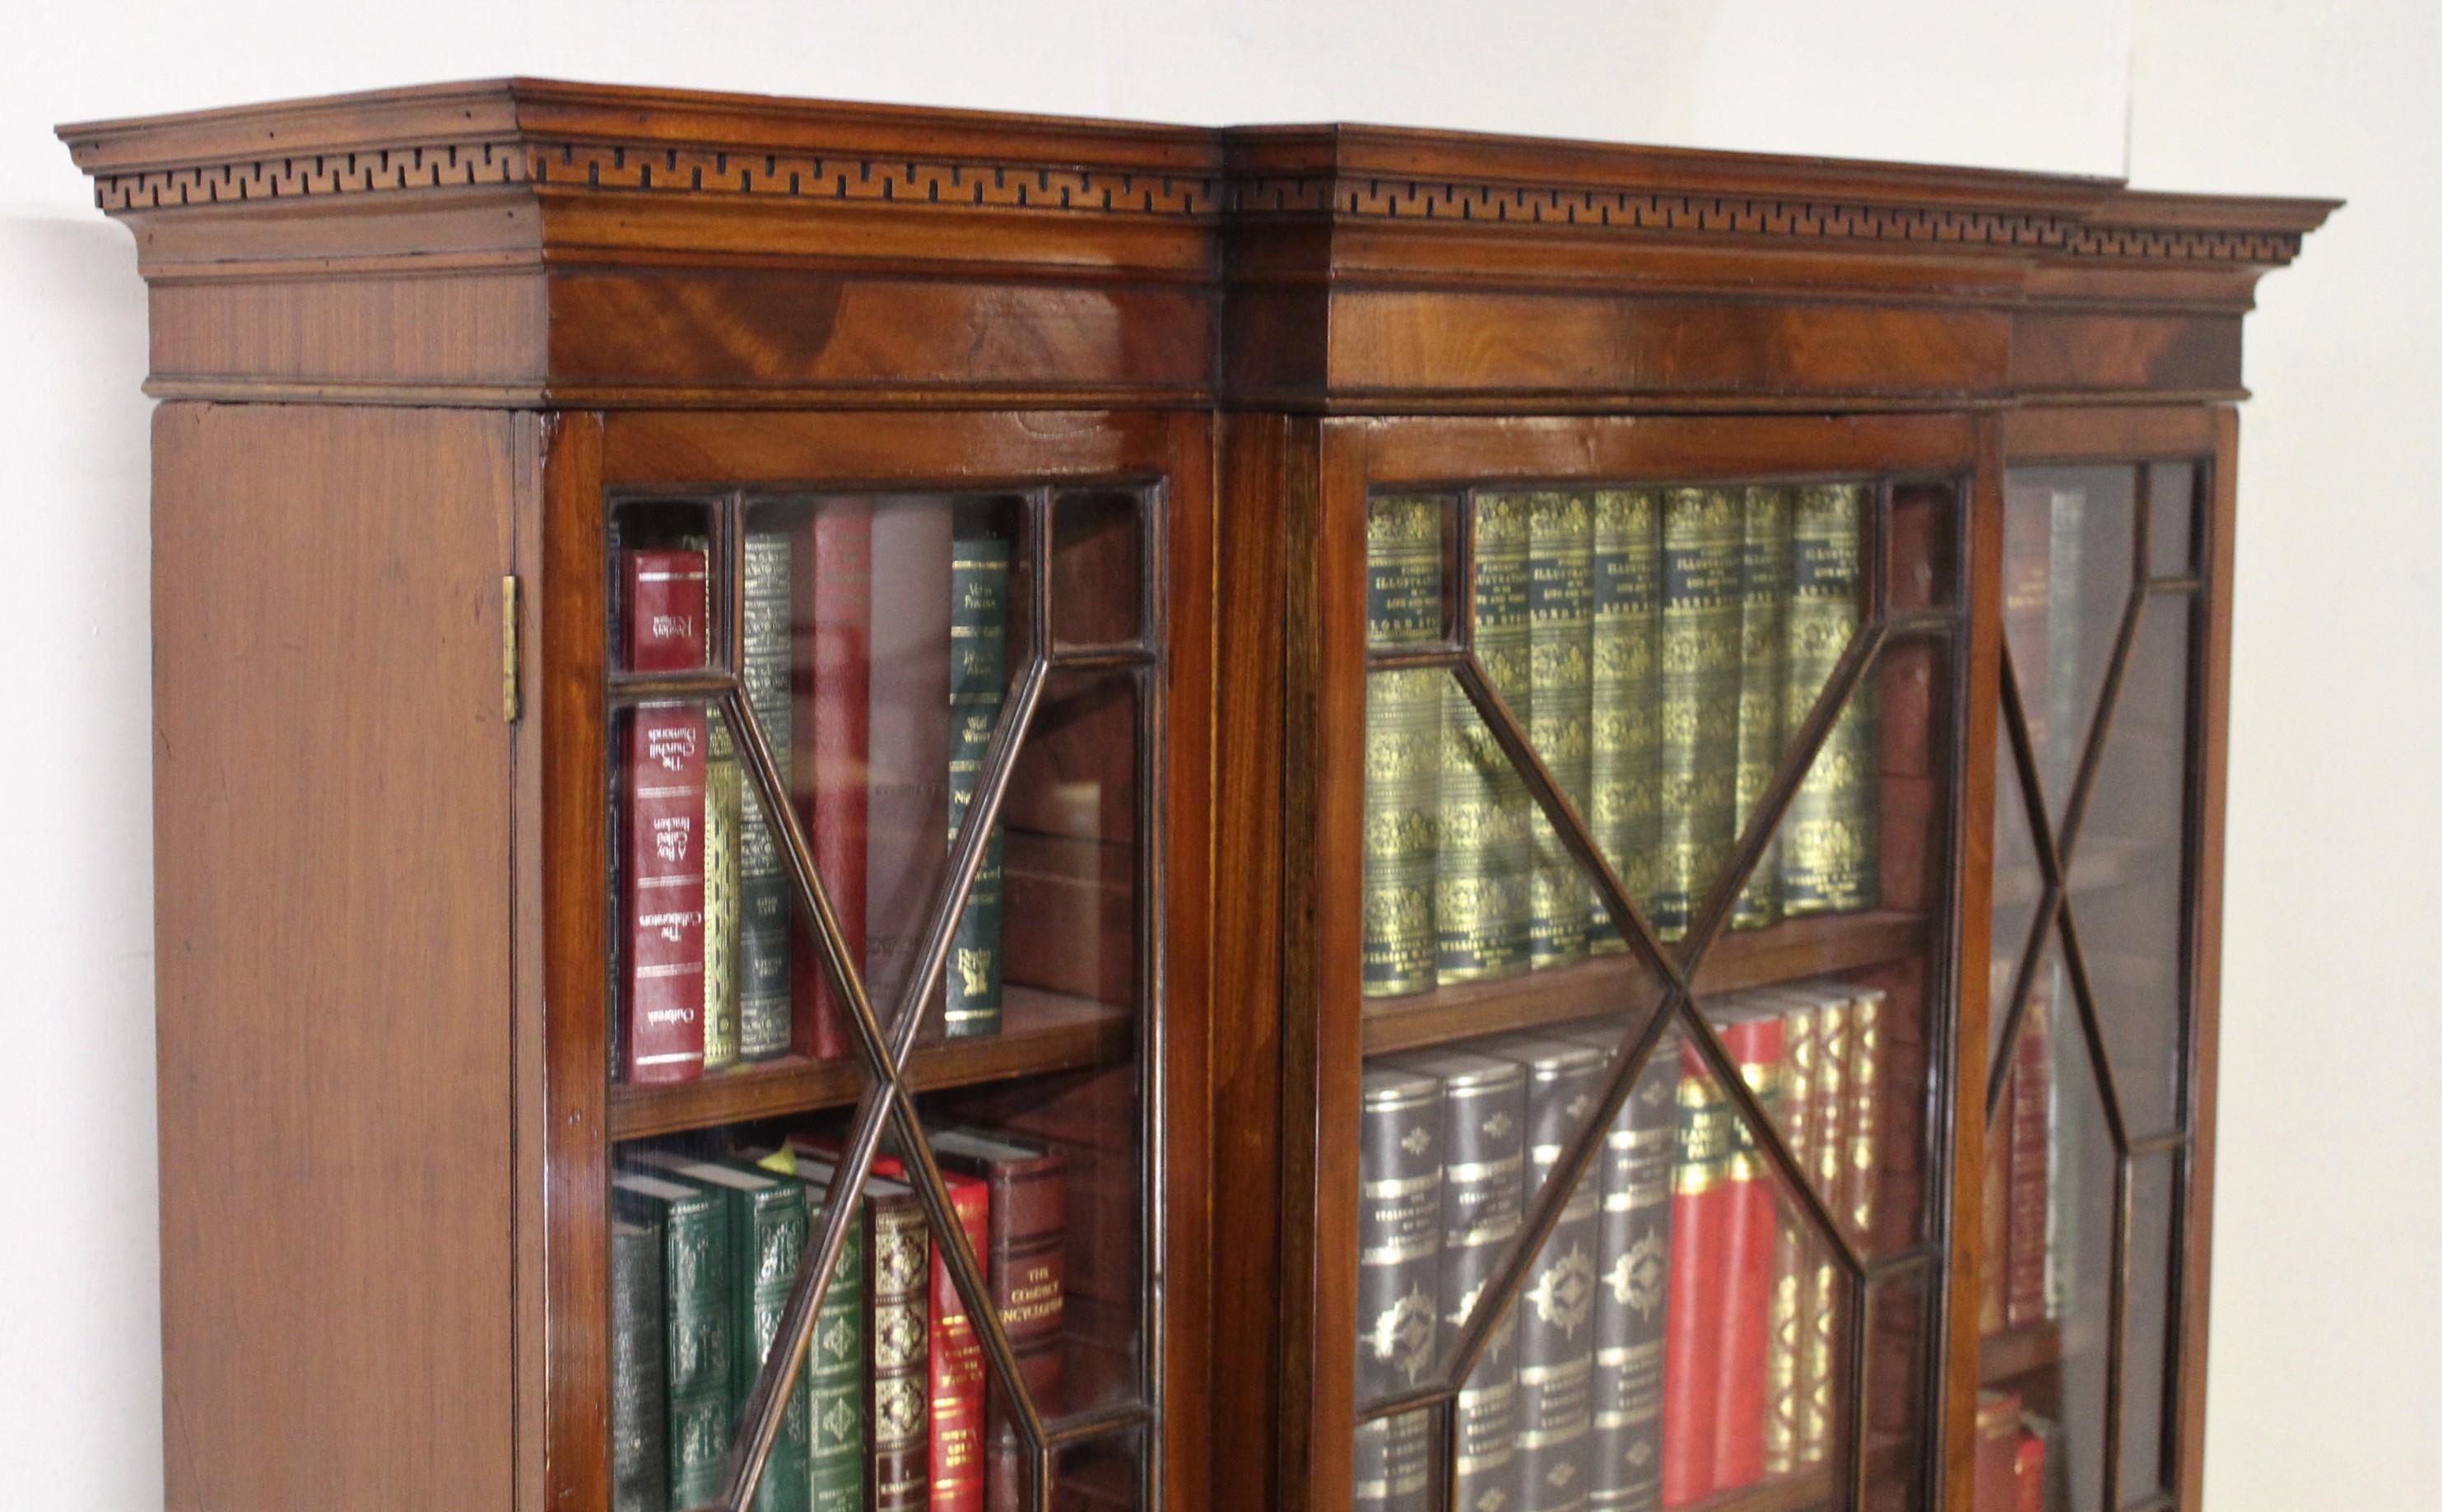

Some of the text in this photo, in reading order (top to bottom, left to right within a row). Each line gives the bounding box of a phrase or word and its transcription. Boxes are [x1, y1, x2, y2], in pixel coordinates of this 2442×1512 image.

[649, 727, 695, 744] Diamonds
[649, 742, 695, 759] Churchill
[663, 756, 683, 771] The
[657, 830, 688, 849] Called
[677, 845, 686, 861] A
[639, 910, 702, 928] Collaborators
[661, 927, 682, 942] The
[648, 1007, 695, 1027] Outbreak
[1026, 1266, 1049, 1283] THE
